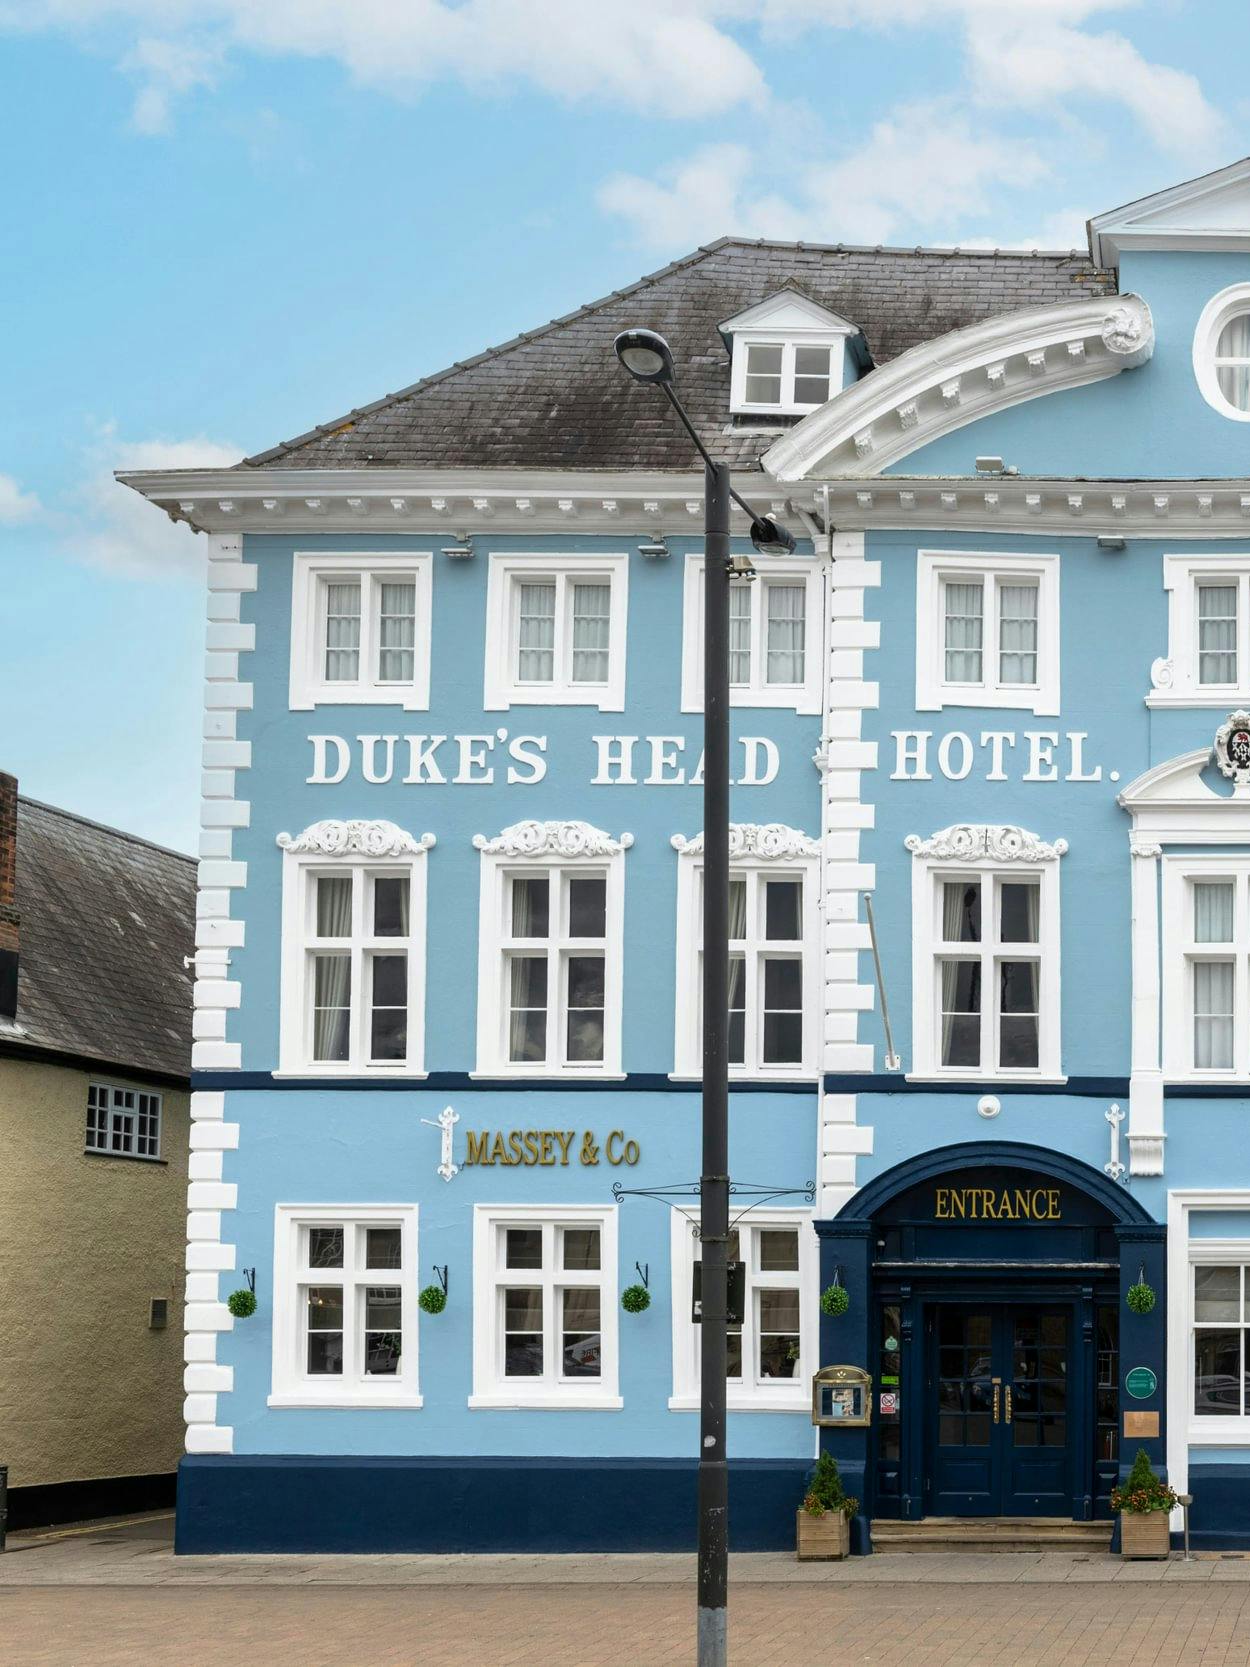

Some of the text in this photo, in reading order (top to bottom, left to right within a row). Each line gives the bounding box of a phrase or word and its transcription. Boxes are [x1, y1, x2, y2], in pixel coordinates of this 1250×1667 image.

[306, 727, 548, 785] DUKE'S
[889, 730, 1121, 782] HOTEL.
[466, 1130, 640, 1166] MASSEY & Co
[935, 1187, 1062, 1220] ENTRANCE
